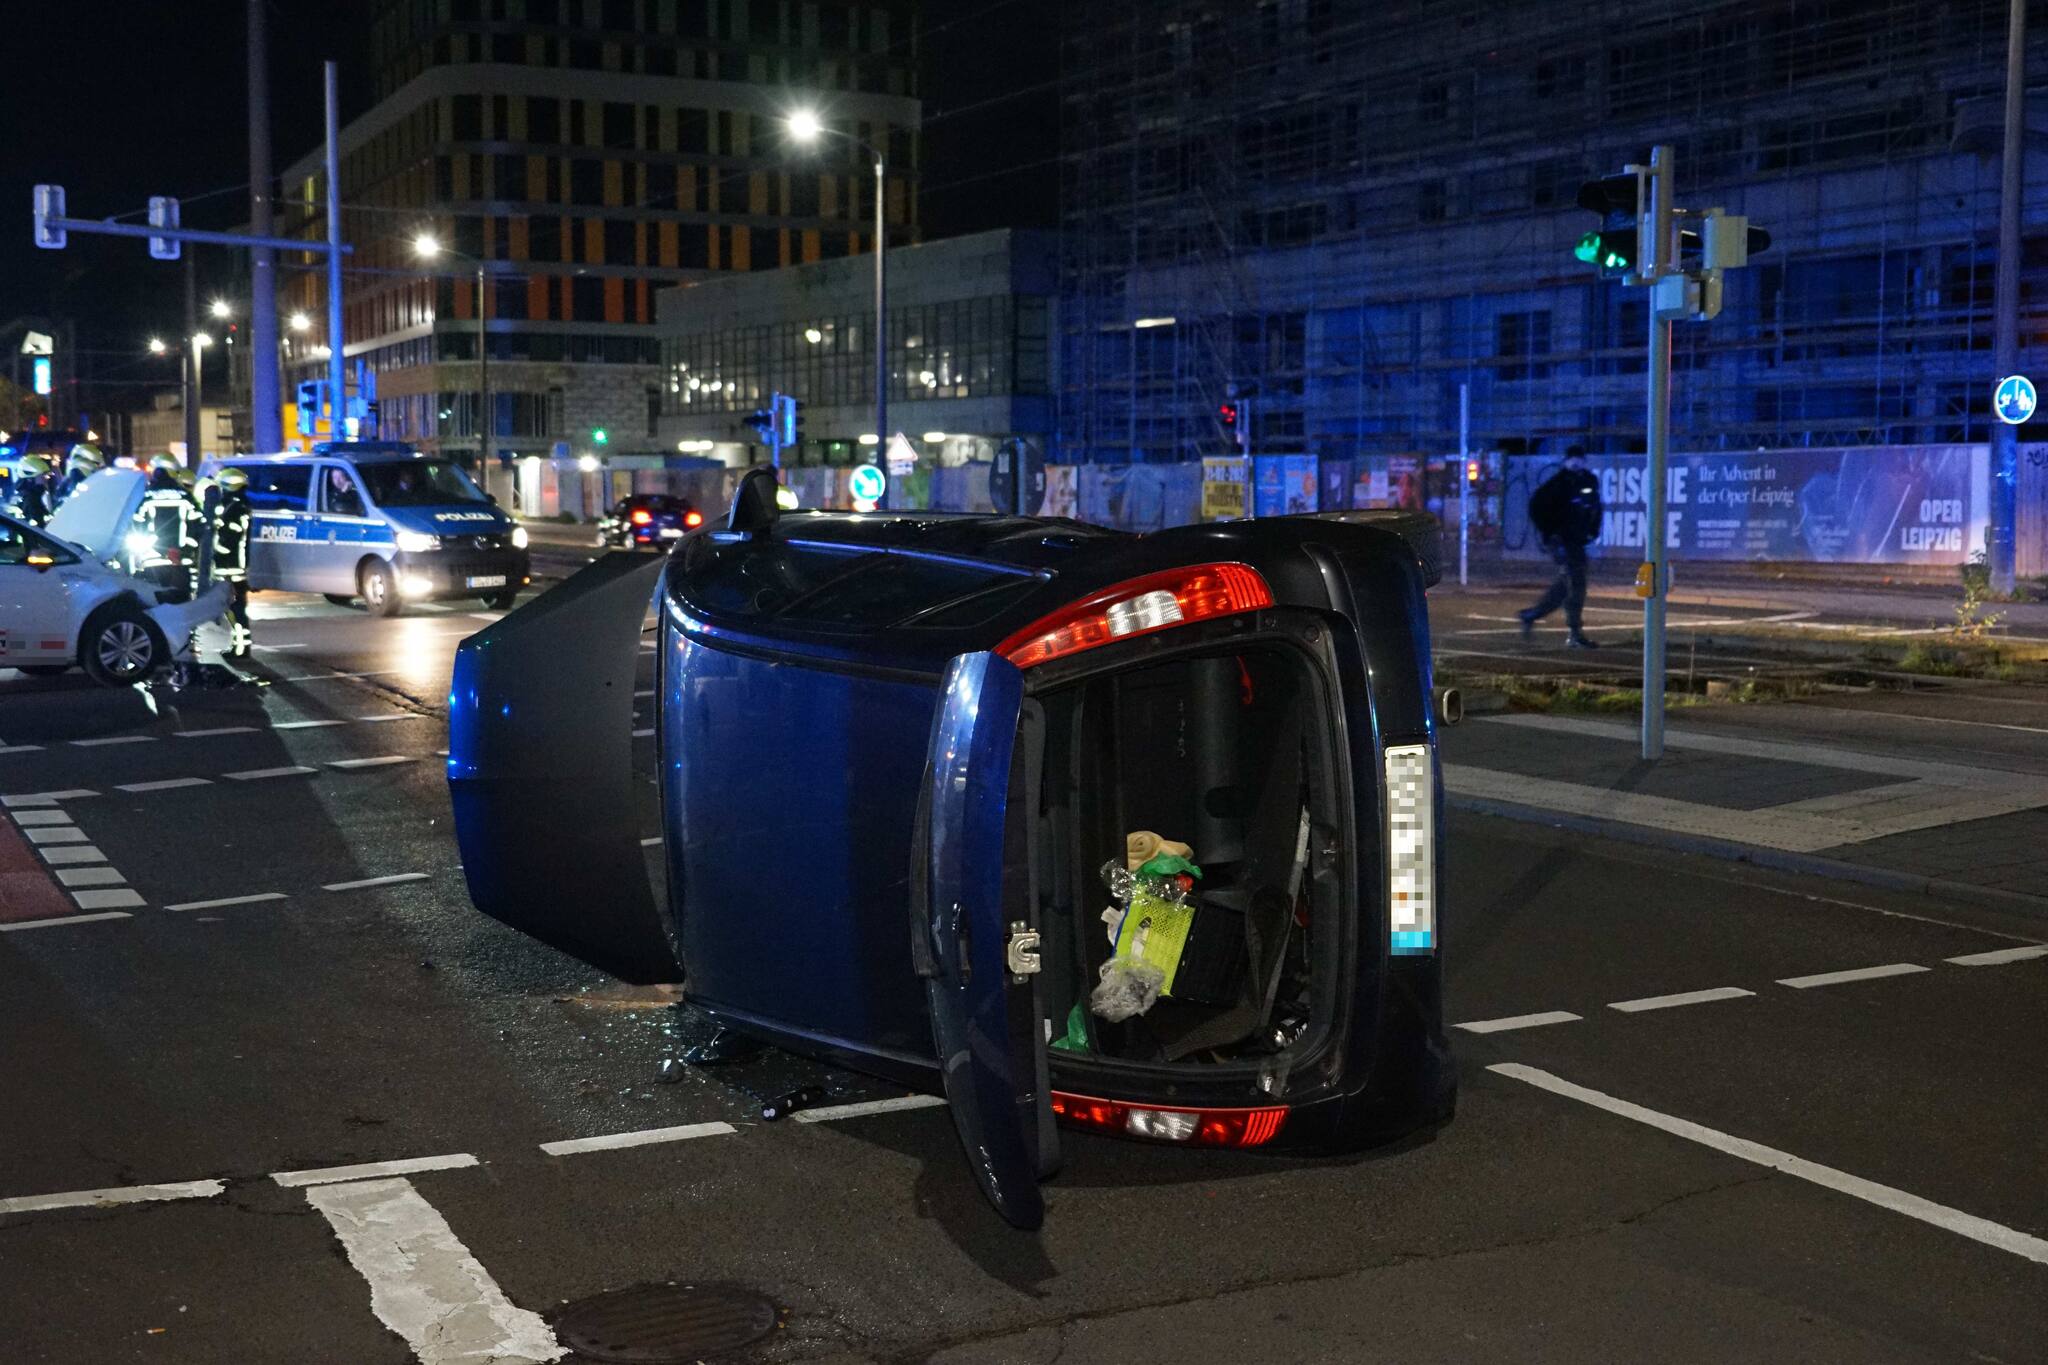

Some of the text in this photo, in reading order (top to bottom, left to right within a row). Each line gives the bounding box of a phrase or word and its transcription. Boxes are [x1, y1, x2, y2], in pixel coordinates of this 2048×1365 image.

[1699, 463, 1776, 482] Ihr Advent in
[1697, 486, 1794, 508] der Oper Leipzig
[434, 512, 495, 522] POLIZEI
[1920, 499, 1963, 523] OPER
[260, 525, 298, 541] POLIZEI
[1594, 511, 1682, 549] MENE
[1901, 527, 1962, 551] LEIPZIG
